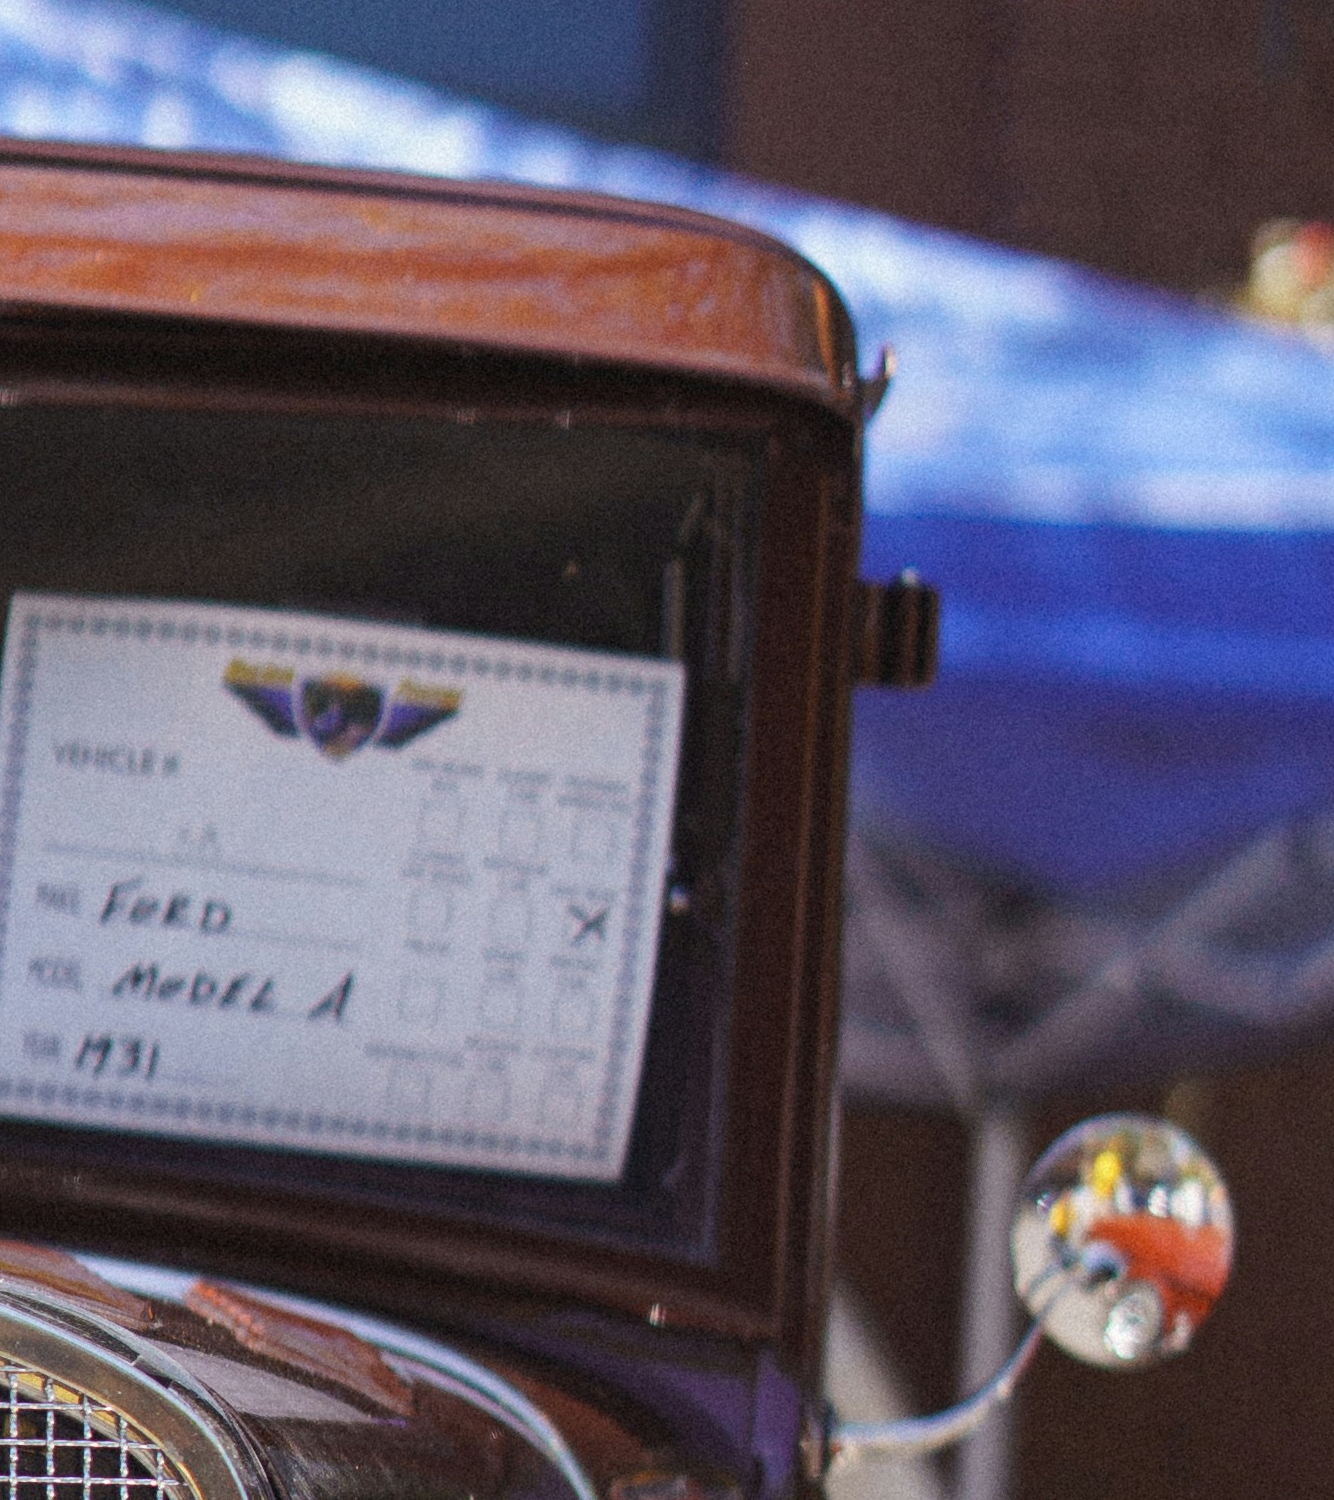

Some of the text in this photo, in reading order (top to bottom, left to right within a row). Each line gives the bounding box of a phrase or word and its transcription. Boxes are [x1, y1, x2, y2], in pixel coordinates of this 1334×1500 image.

[52, 740, 155, 778] VEHICLE
[98, 873, 234, 935] FORD
[111, 960, 278, 1018] MODEL
[304, 967, 360, 1030] A
[73, 1031, 162, 1084] 1931
